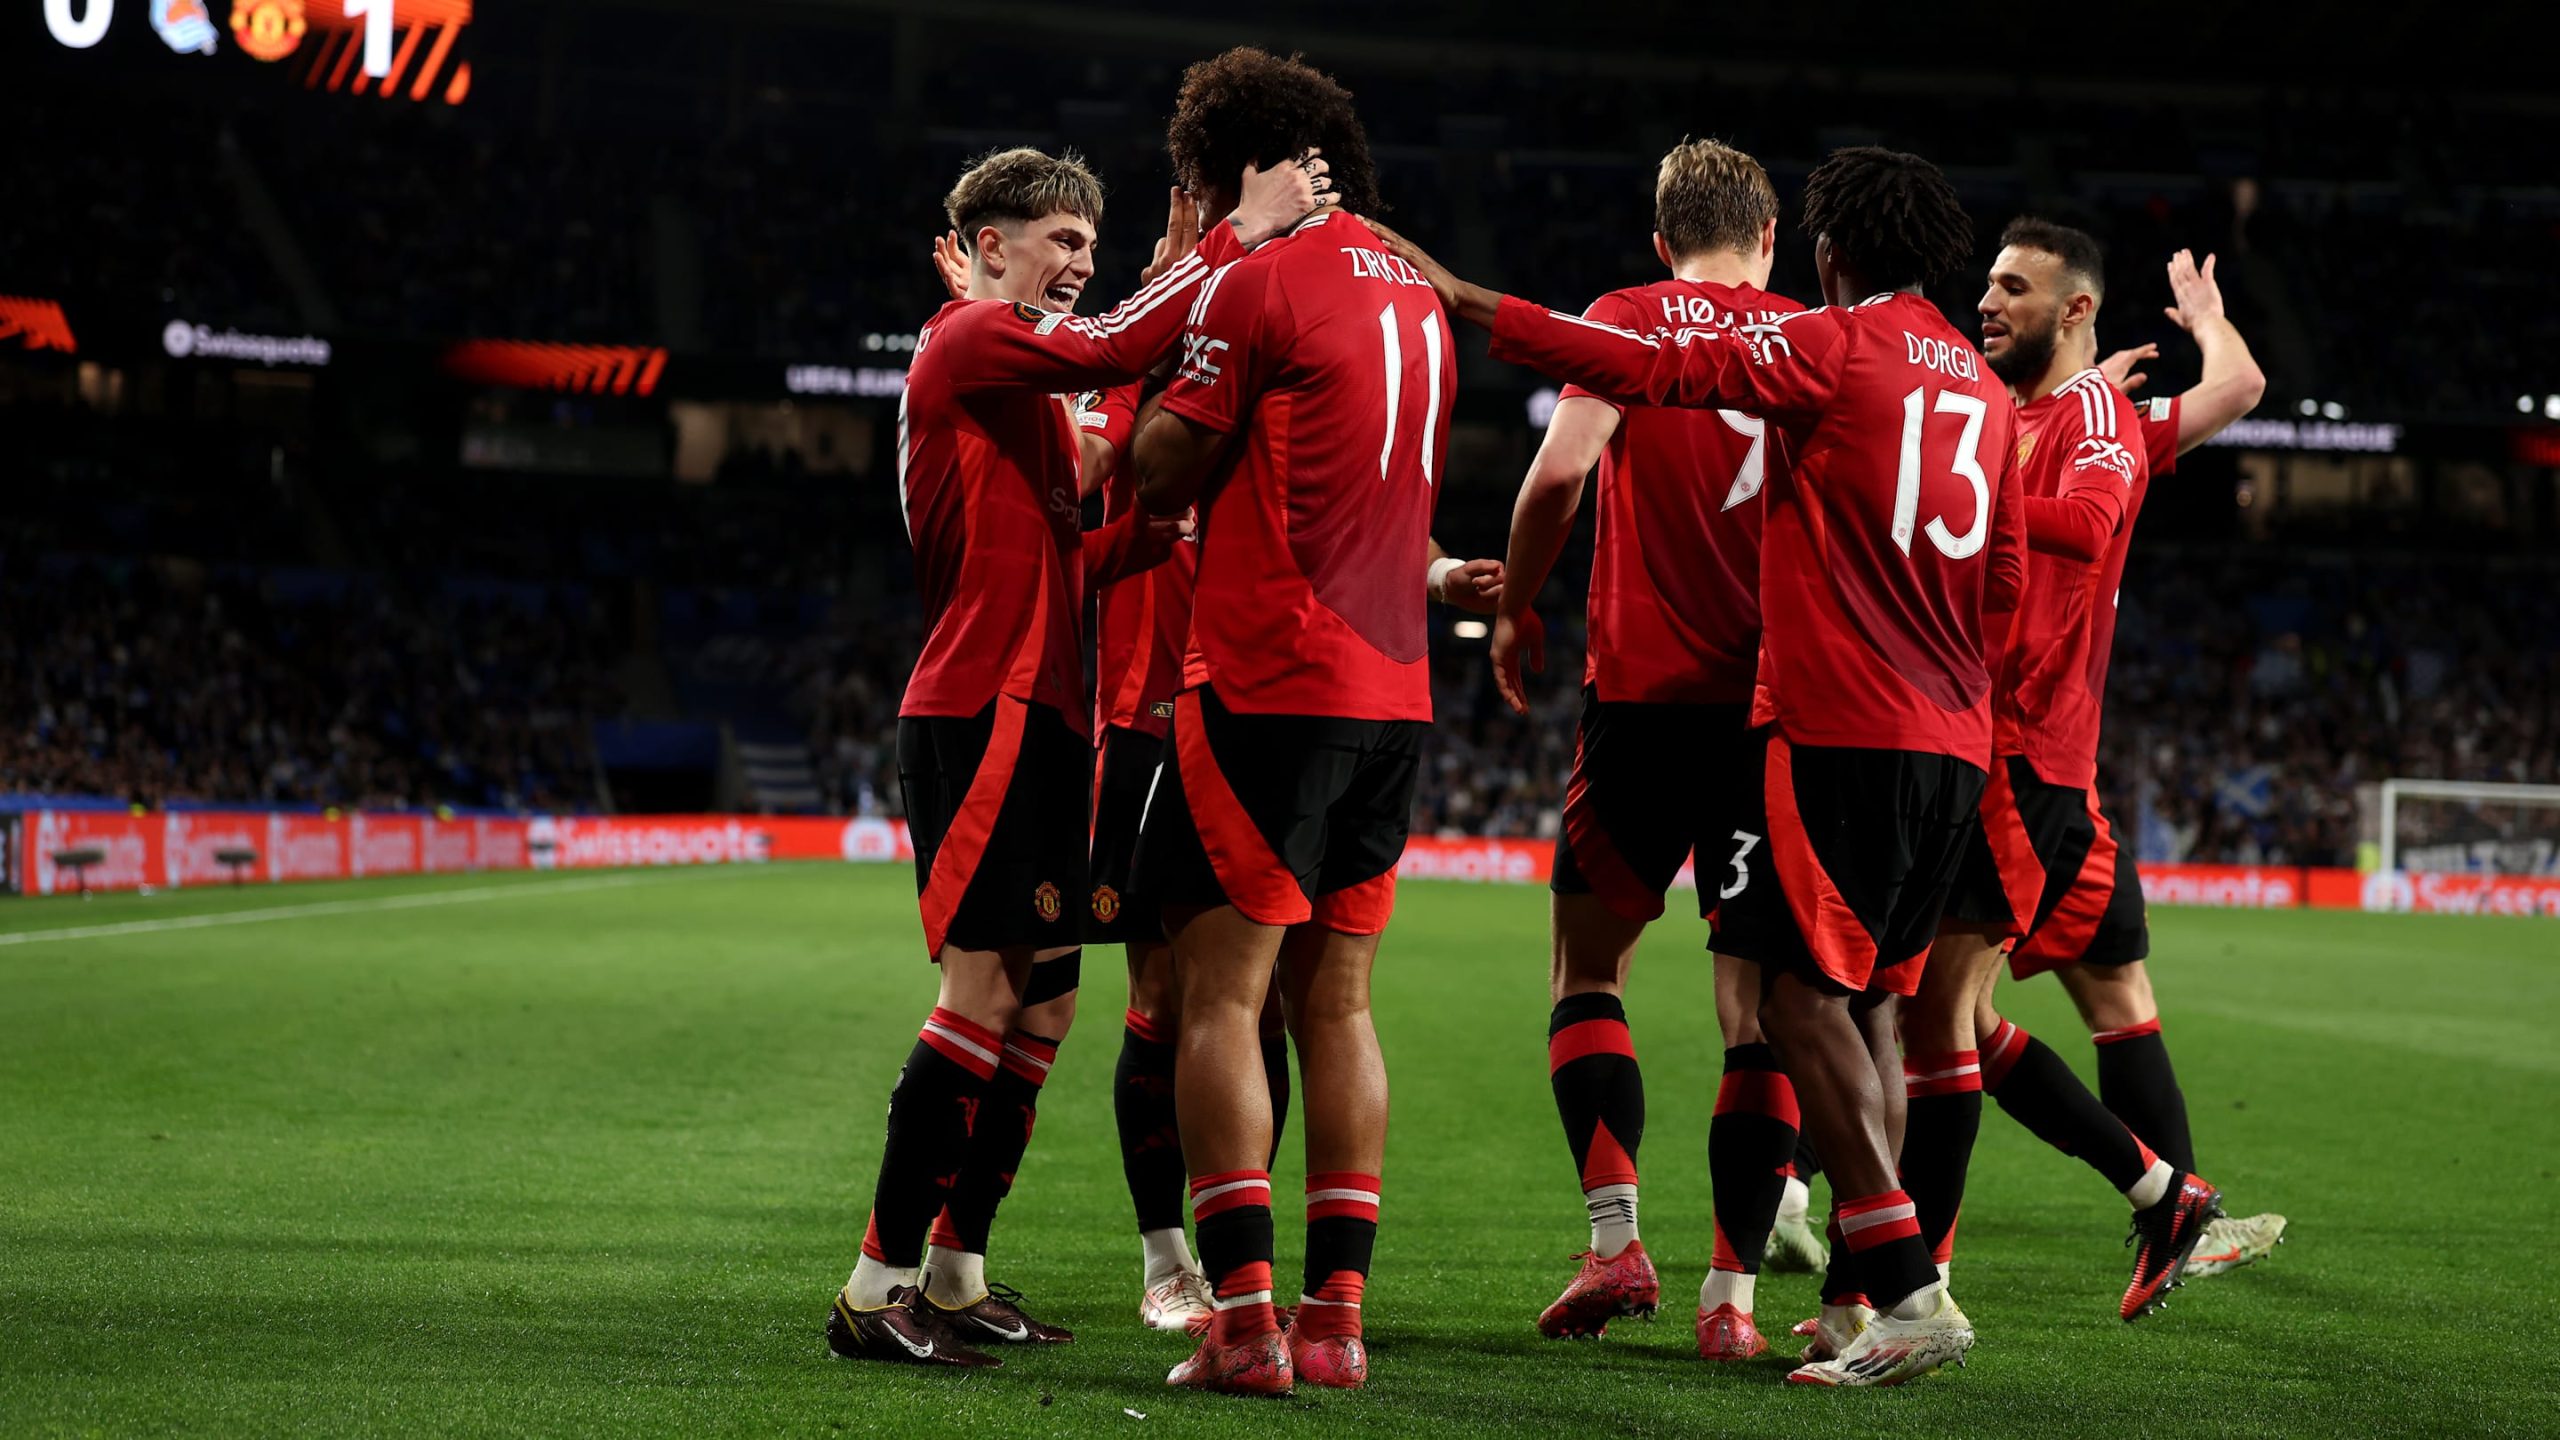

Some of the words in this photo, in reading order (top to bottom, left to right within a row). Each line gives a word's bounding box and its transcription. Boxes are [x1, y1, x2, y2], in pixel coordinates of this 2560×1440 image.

[1903, 328, 1979, 382] DORGU
[1379, 301, 1442, 487] 11
[1891, 386, 1990, 560] 13
[1400, 841, 1536, 883] quote
[1720, 829, 1762, 899] 3
